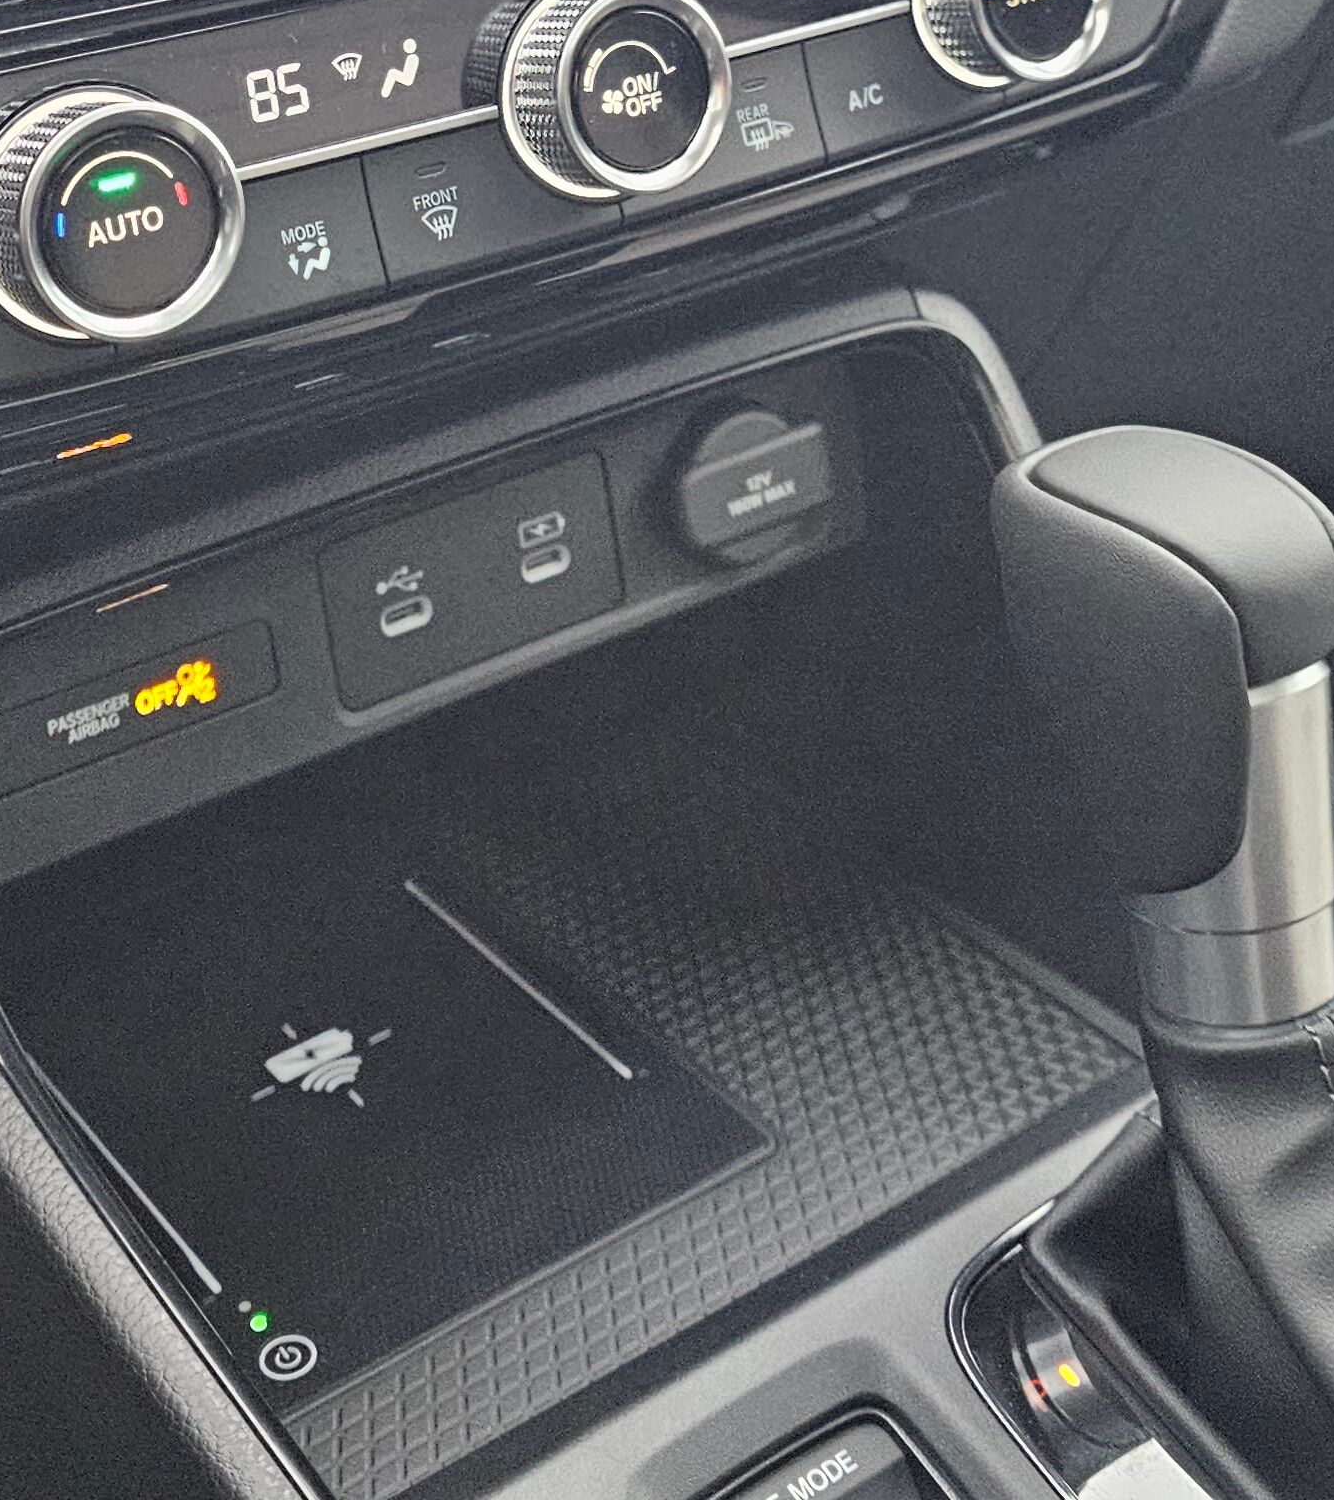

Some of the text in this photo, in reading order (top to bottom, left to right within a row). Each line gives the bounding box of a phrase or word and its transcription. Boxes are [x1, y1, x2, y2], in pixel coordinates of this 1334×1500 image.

[246, 62, 310, 123] 85
[622, 71, 660, 98] ON/
[848, 83, 884, 113] A/C
[625, 90, 663, 117] OFF
[736, 103, 769, 123] REAR
[412, 185, 459, 212] FRONT
[88, 205, 164, 249] AUTO
[280, 220, 327, 247] MODE
[134, 679, 179, 717] OFF
[47, 692, 130, 738] PASSENGER
[68, 713, 121, 745] AIRBAG
[787, 1449, 859, 1500] MODE
